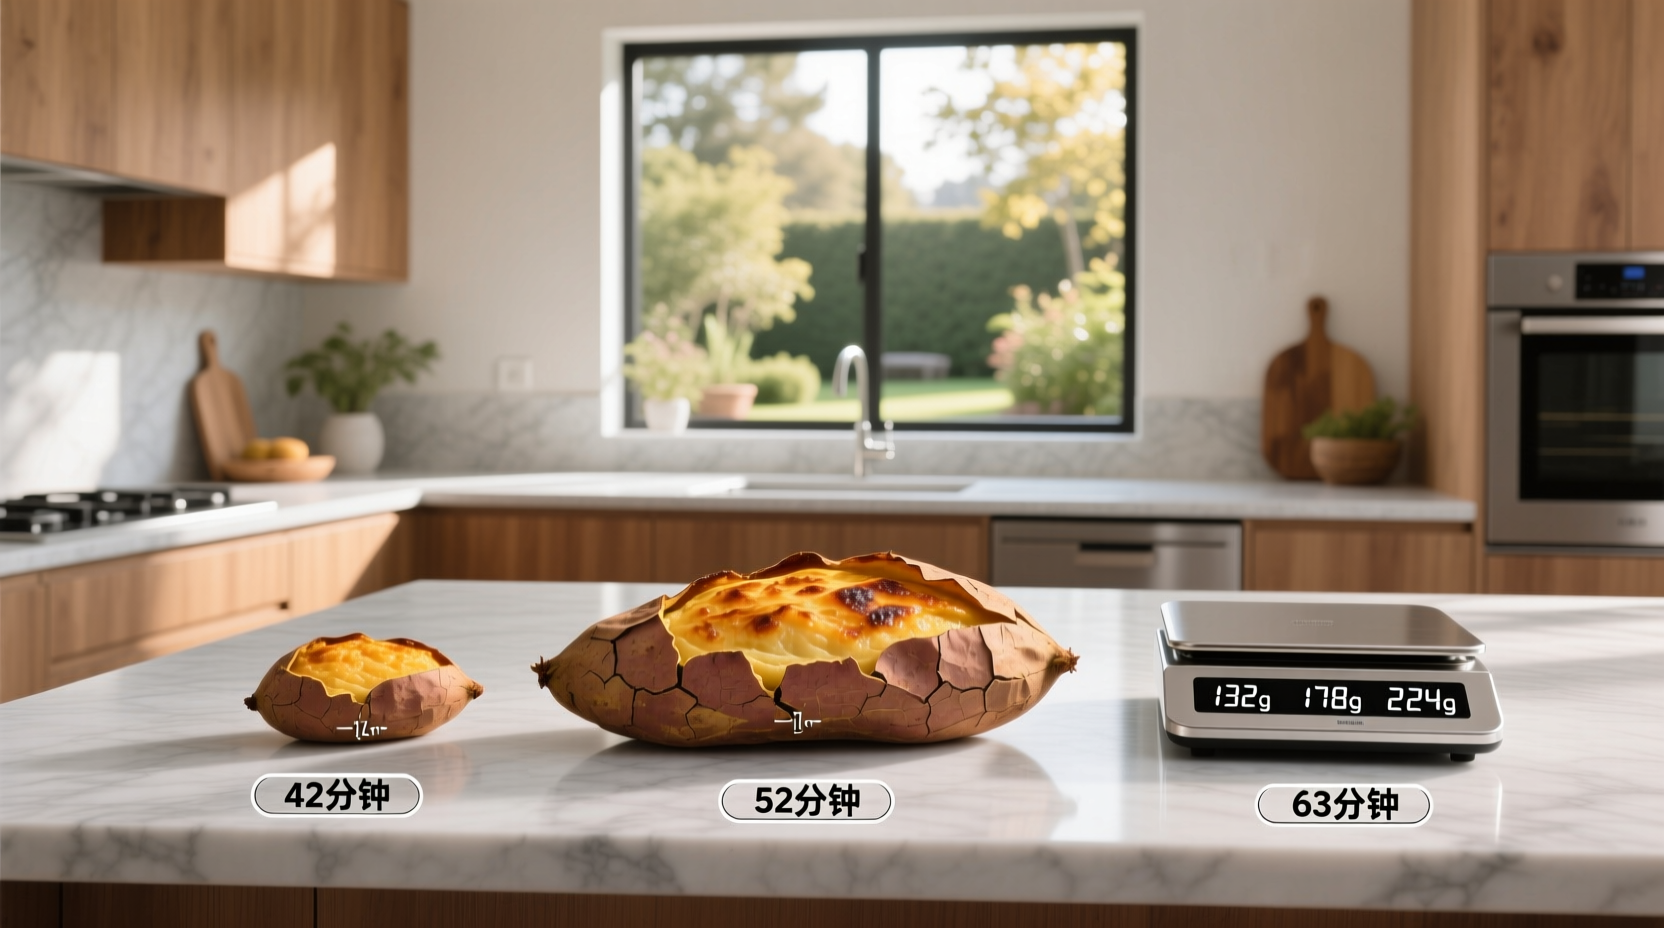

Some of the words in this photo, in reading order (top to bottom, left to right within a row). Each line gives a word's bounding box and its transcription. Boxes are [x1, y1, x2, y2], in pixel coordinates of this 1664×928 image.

[1216, 684, 1270, 711] 132g
[1305, 686, 1361, 713] 178g
[1388, 687, 1456, 715] 224g
